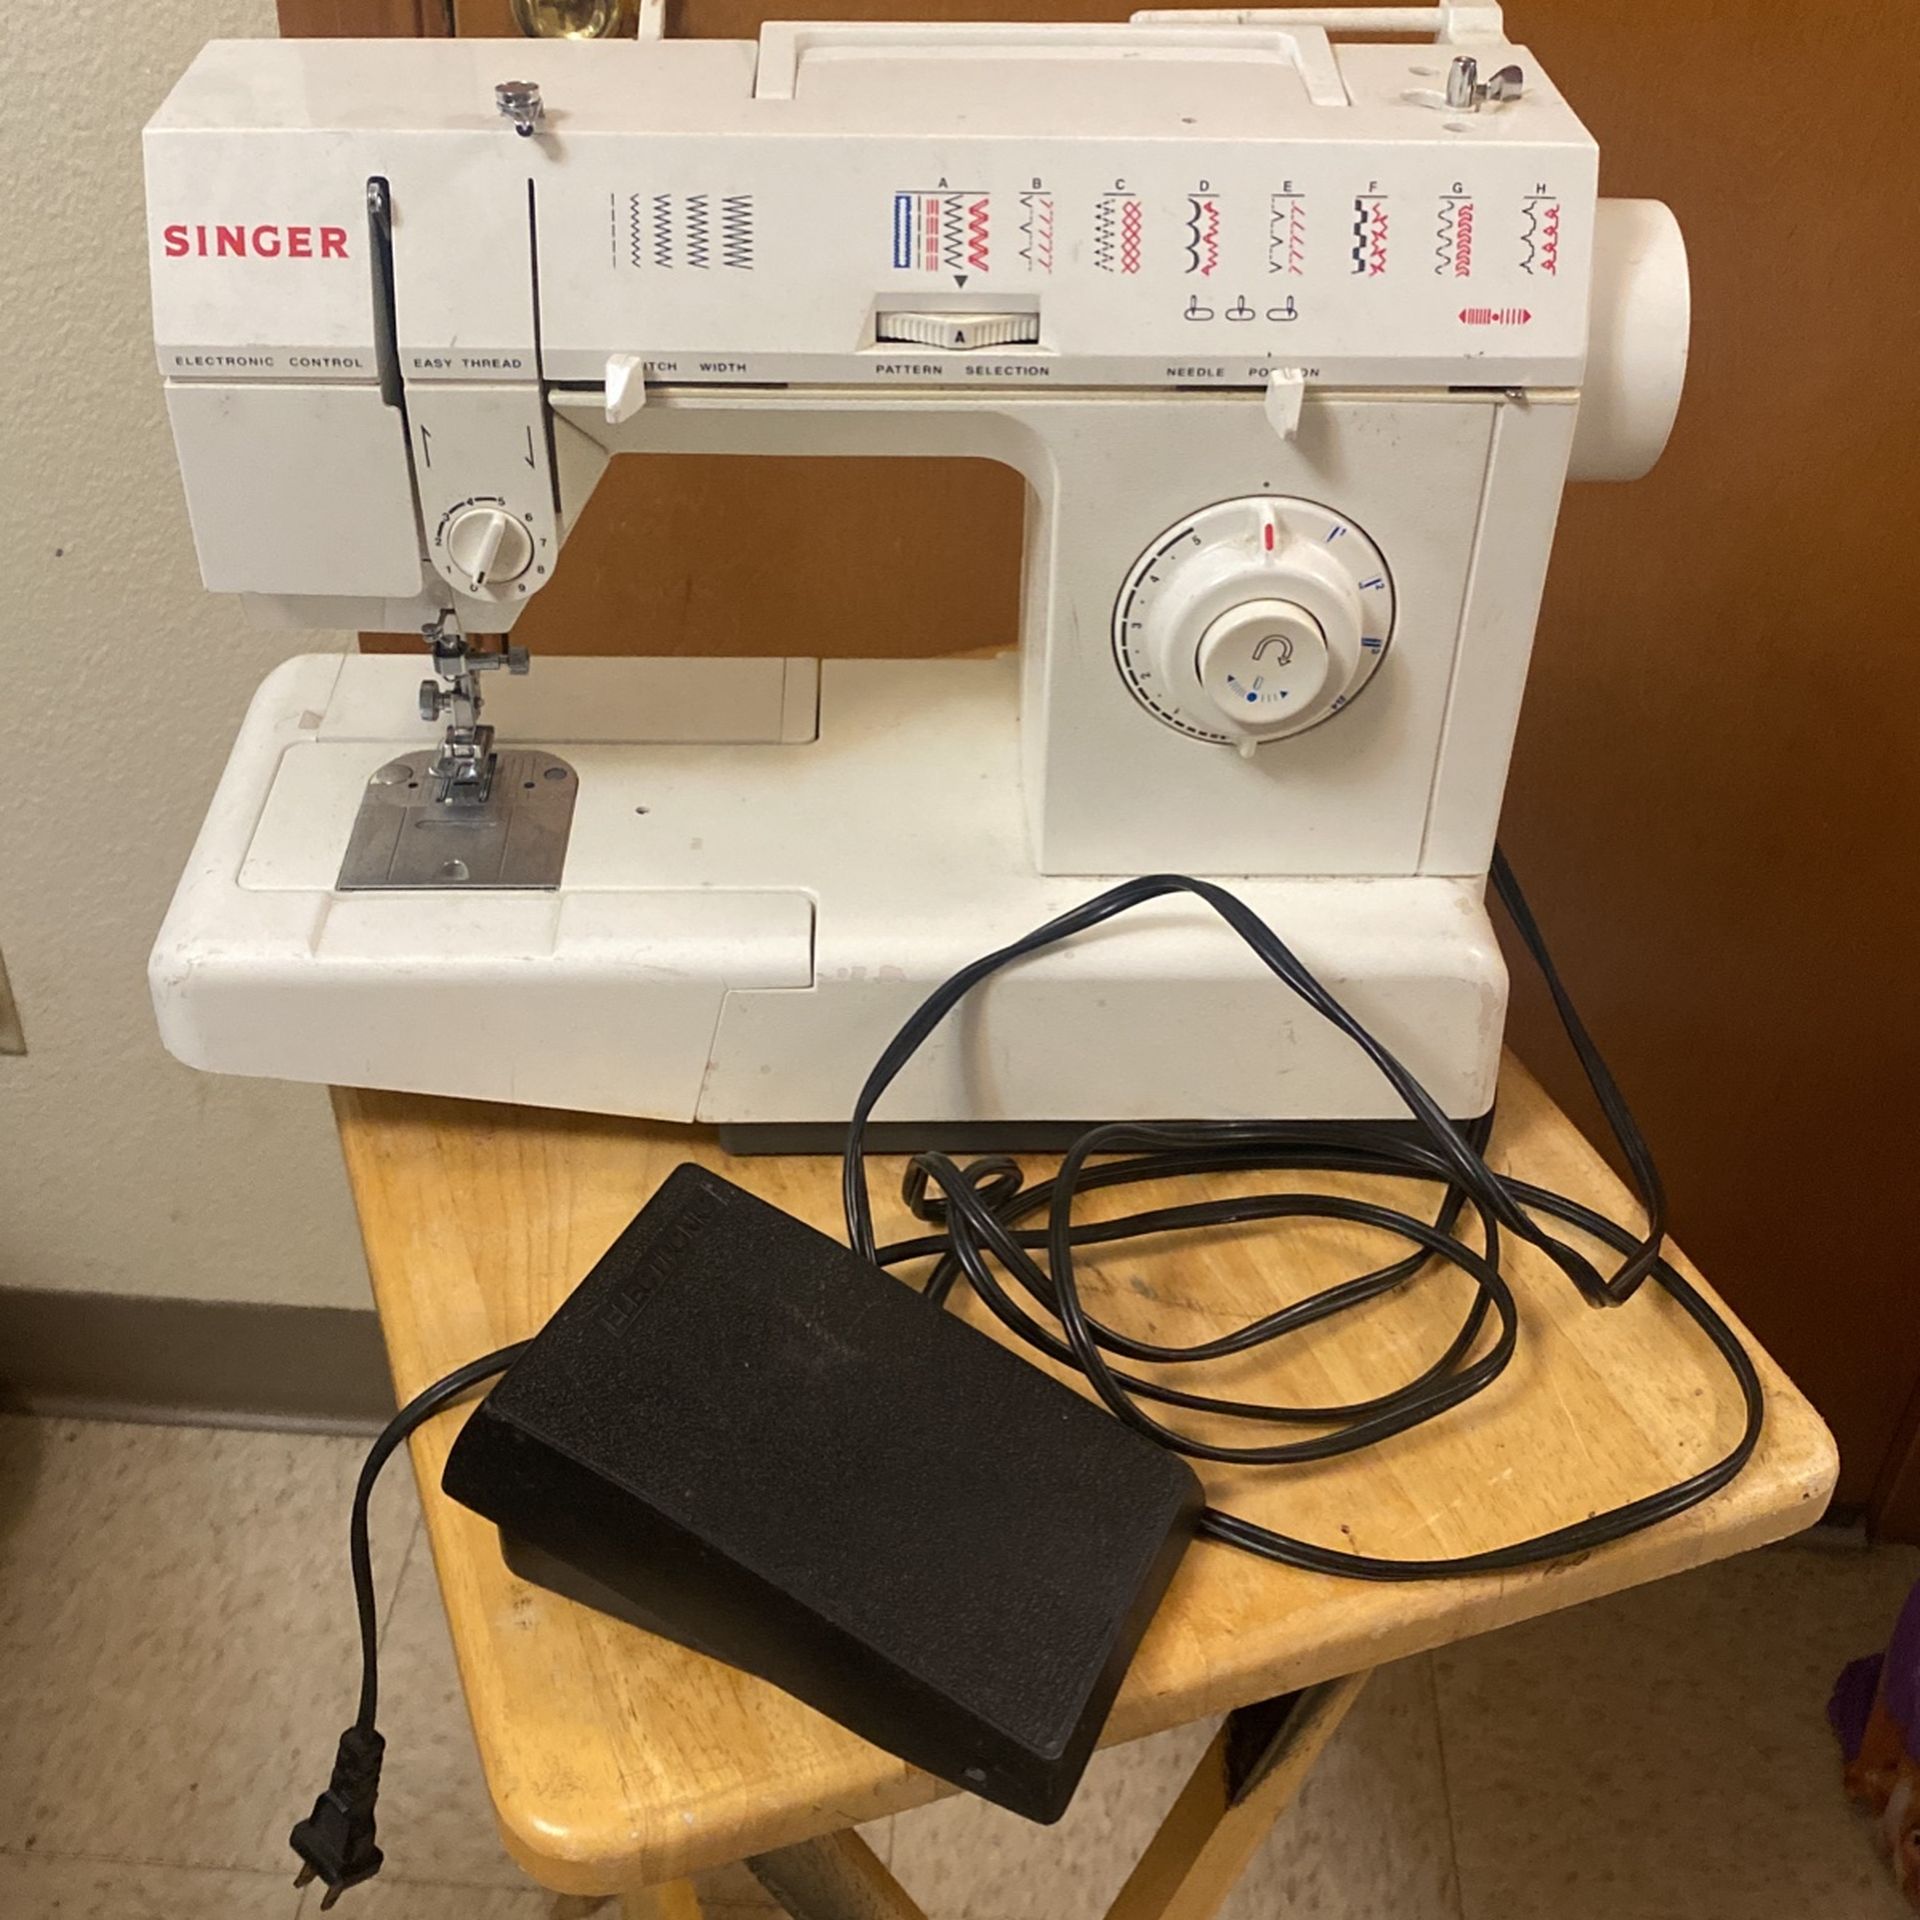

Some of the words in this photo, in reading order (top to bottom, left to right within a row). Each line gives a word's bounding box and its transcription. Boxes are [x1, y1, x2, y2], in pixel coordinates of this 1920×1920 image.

[938, 177, 948, 189] A
[1032, 177, 1042, 190] B
[1115, 178, 1126, 191] C
[1199, 180, 1210, 192] D
[1283, 180, 1293, 193] E
[1368, 181, 1378, 193] F
[1452, 182, 1463, 194] G
[1536, 183, 1546, 194] H
[163, 225, 349, 258] SINGER
[954, 330, 965, 343] A
[175, 356, 275, 367] ELECTRONIC
[289, 357, 363, 368] CONTROL
[414, 358, 452, 368] EASY
[462, 358, 522, 369] THREAD
[643, 361, 677, 372] ITCH
[700, 362, 746, 373] WIDTH
[875, 364, 943, 375] PATTERN
[965, 366, 1050, 376] SELECTION
[1166, 367, 1225, 378] NEEDLE
[1248, 368, 1320, 378] POON
[441, 512, 451, 522] 3
[524, 512, 533, 522] 6
[434, 537, 442, 547] 2
[539, 537, 547, 547] 7
[1191, 534, 1202, 546] 5
